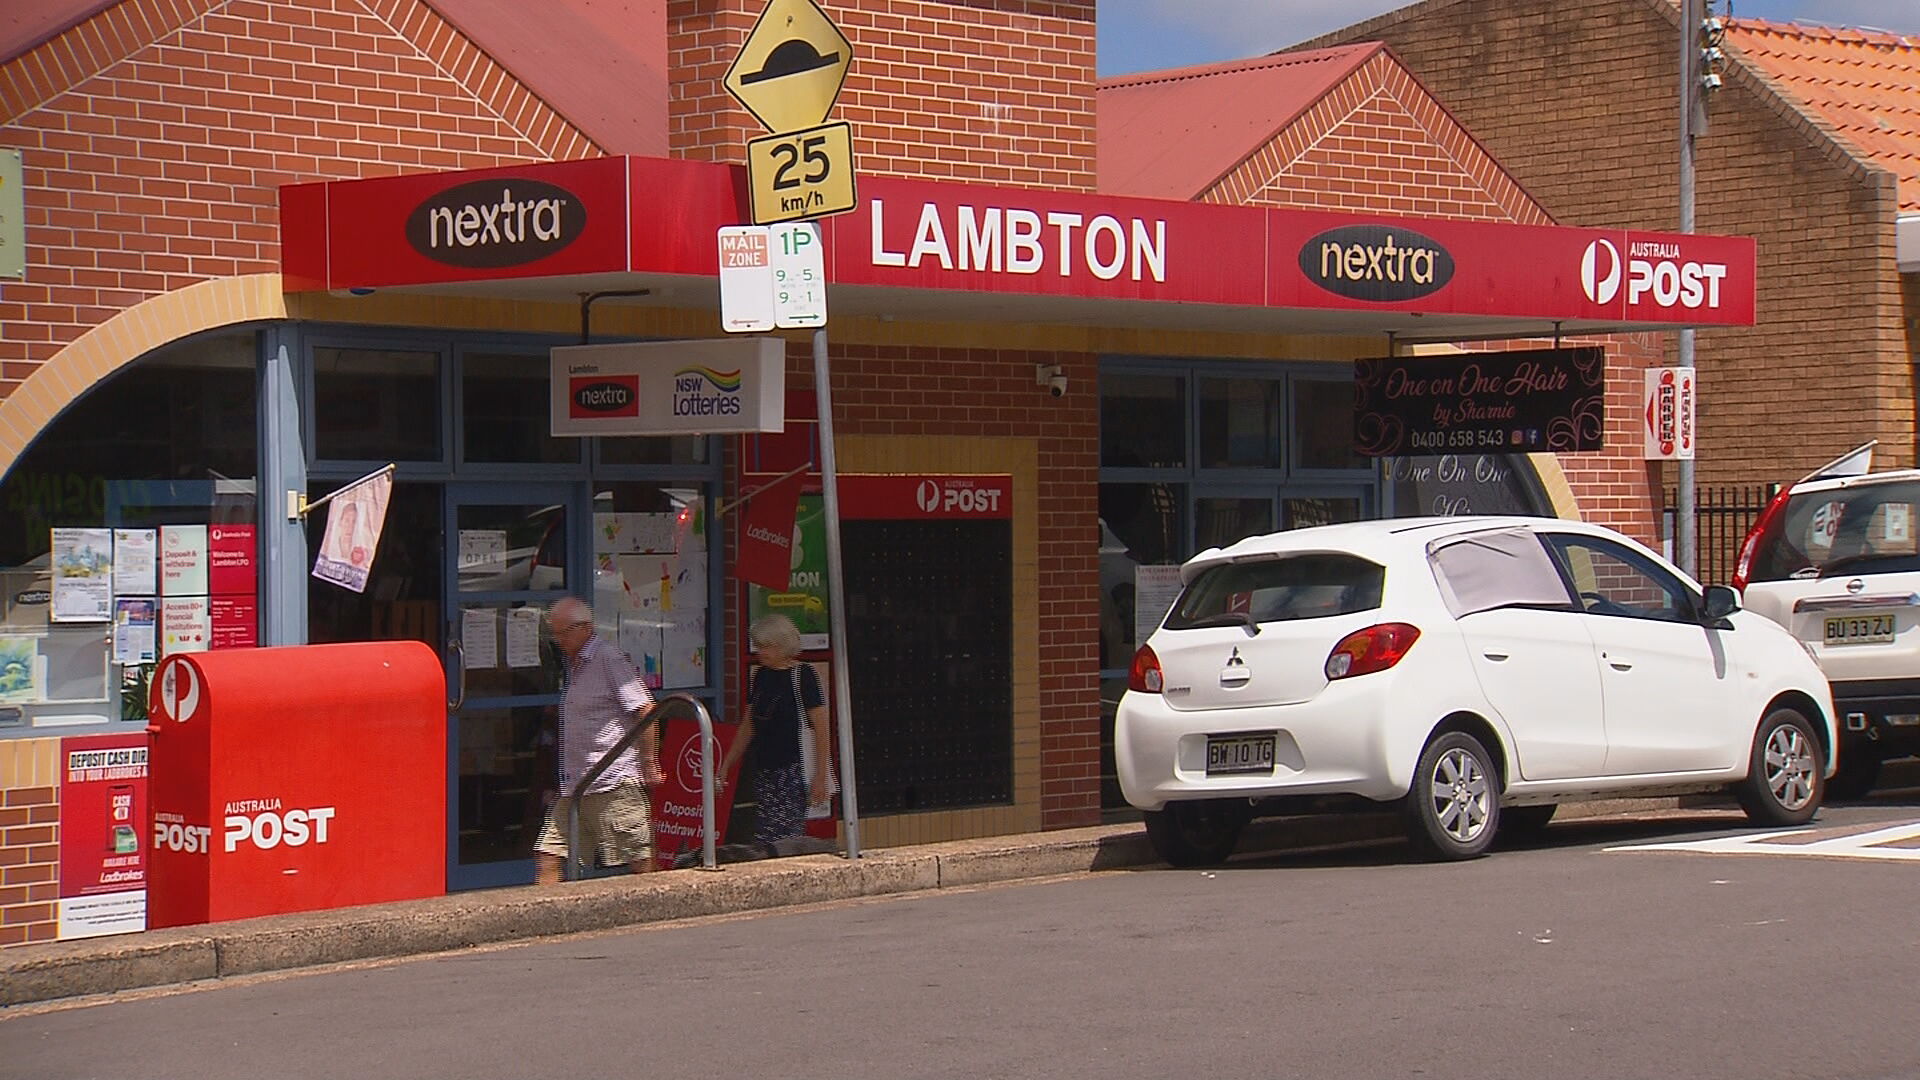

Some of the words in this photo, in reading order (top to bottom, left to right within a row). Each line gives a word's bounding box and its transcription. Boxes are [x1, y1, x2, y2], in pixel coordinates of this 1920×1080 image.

[770, 136, 830, 191] 25
[781, 190, 824, 212] km/h
[430, 188, 561, 249] nextra
[723, 237, 765, 250] MAIL
[781, 231, 812, 255] 1P
[871, 199, 1166, 282] LAMBTON
[1629, 242, 1680, 258] AUSTRALIA
[728, 252, 762, 266] ZONE
[1321, 234, 1433, 284] nextra
[1629, 260, 1726, 308] POST
[569, 364, 599, 374] Lambton
[676, 378, 703, 393] NSW
[1385, 367, 1426, 399] One
[1431, 379, 1454, 395] on
[1458, 364, 1501, 396] One
[1504, 362, 1569, 396] Hair
[581, 387, 627, 405] nextra
[673, 394, 740, 416] Lotteries
[1433, 402, 1450, 429] by
[1662, 386, 1672, 440] BARBER
[1411, 429, 1445, 448] 0400
[1449, 430, 1474, 447] 658
[1478, 429, 1504, 446] 543
[1438, 455, 1466, 483] On
[944, 489, 1001, 513] POST
[747, 523, 790, 549] Ladbrokes
[165, 550, 191, 558] Deposit
[1826, 620, 1846, 638] BU
[1850, 620, 1869, 637] 33
[1873, 618, 1892, 636] ZJ
[70, 752, 106, 769] DEPOSIT
[107, 751, 130, 766] CASH
[1255, 742, 1271, 762] TG
[225, 798, 282, 815] AUSTRALIA
[663, 800, 704, 818] Deposit
[154, 823, 212, 854] POST
[225, 807, 336, 853] POST
[655, 820, 697, 837] ithdraw
